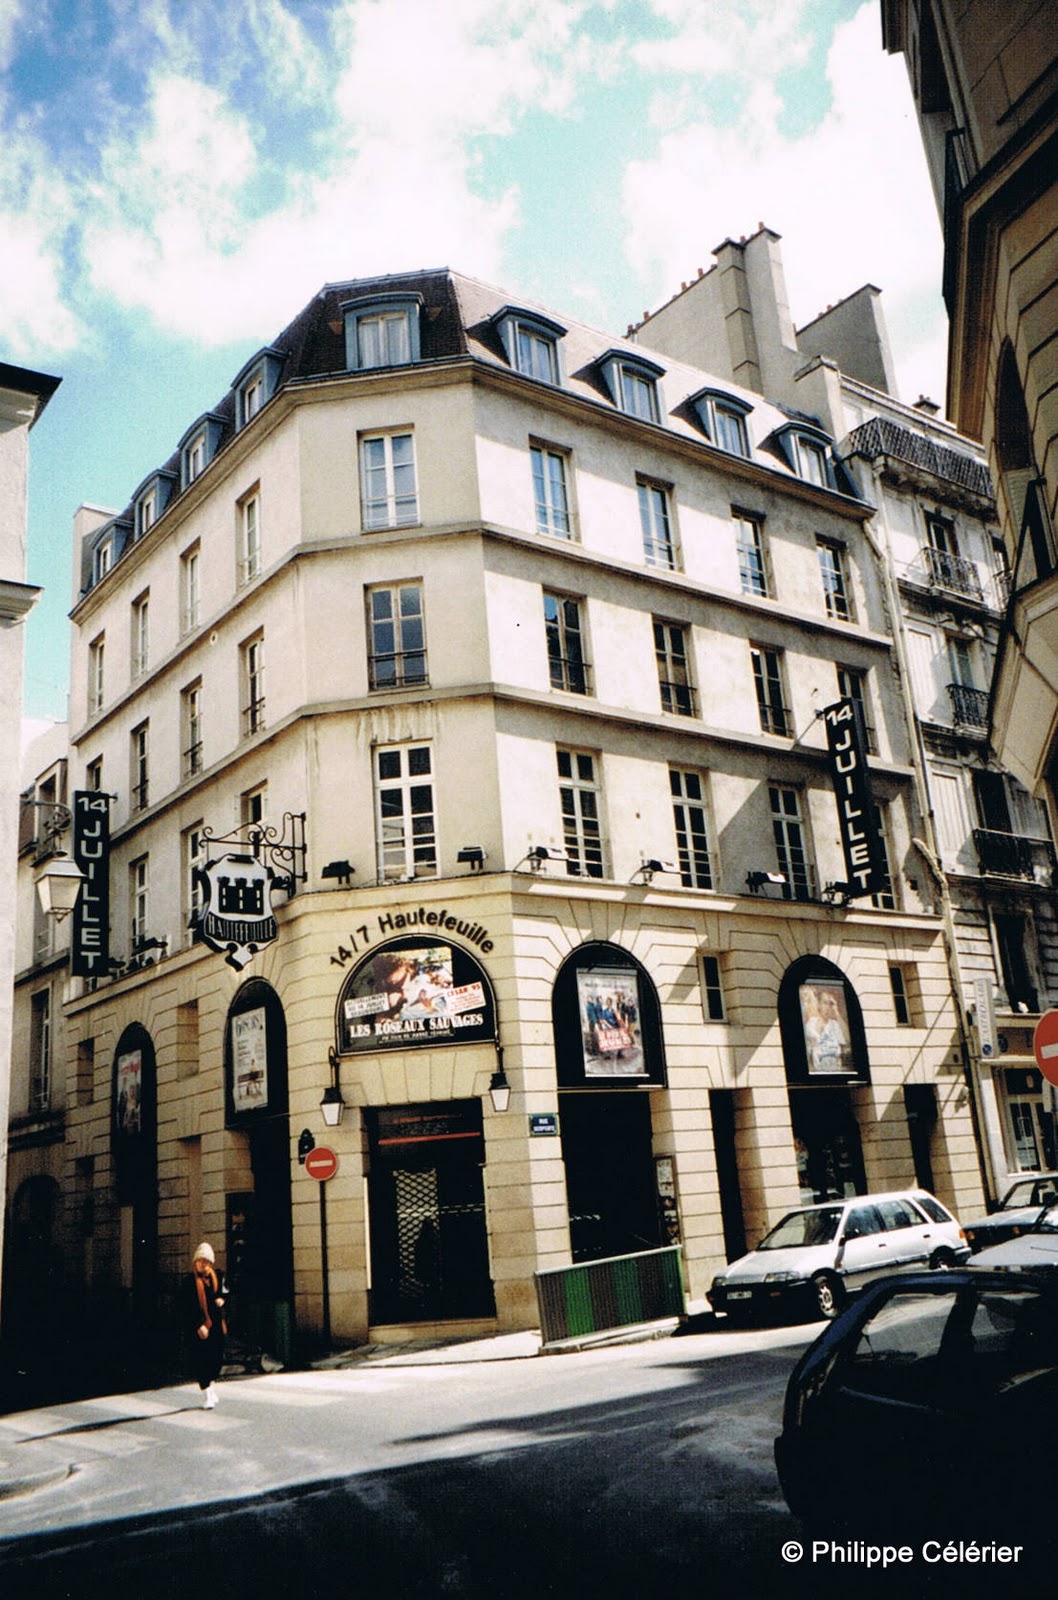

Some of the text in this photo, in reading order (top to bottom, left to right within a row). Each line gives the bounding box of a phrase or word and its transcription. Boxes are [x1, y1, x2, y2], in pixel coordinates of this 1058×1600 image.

[826, 705, 872, 890] 14 JUILLET
[77, 797, 108, 970] 14 JUILLET
[207, 913, 274, 941] HAUTEFEUILLE
[329, 907, 494, 968] 14/7 Hautefeuille
[350, 1023, 371, 1038] LES
[375, 1018, 425, 1036] ROSEAUX
[429, 1013, 484, 1030] SAUVAGES
